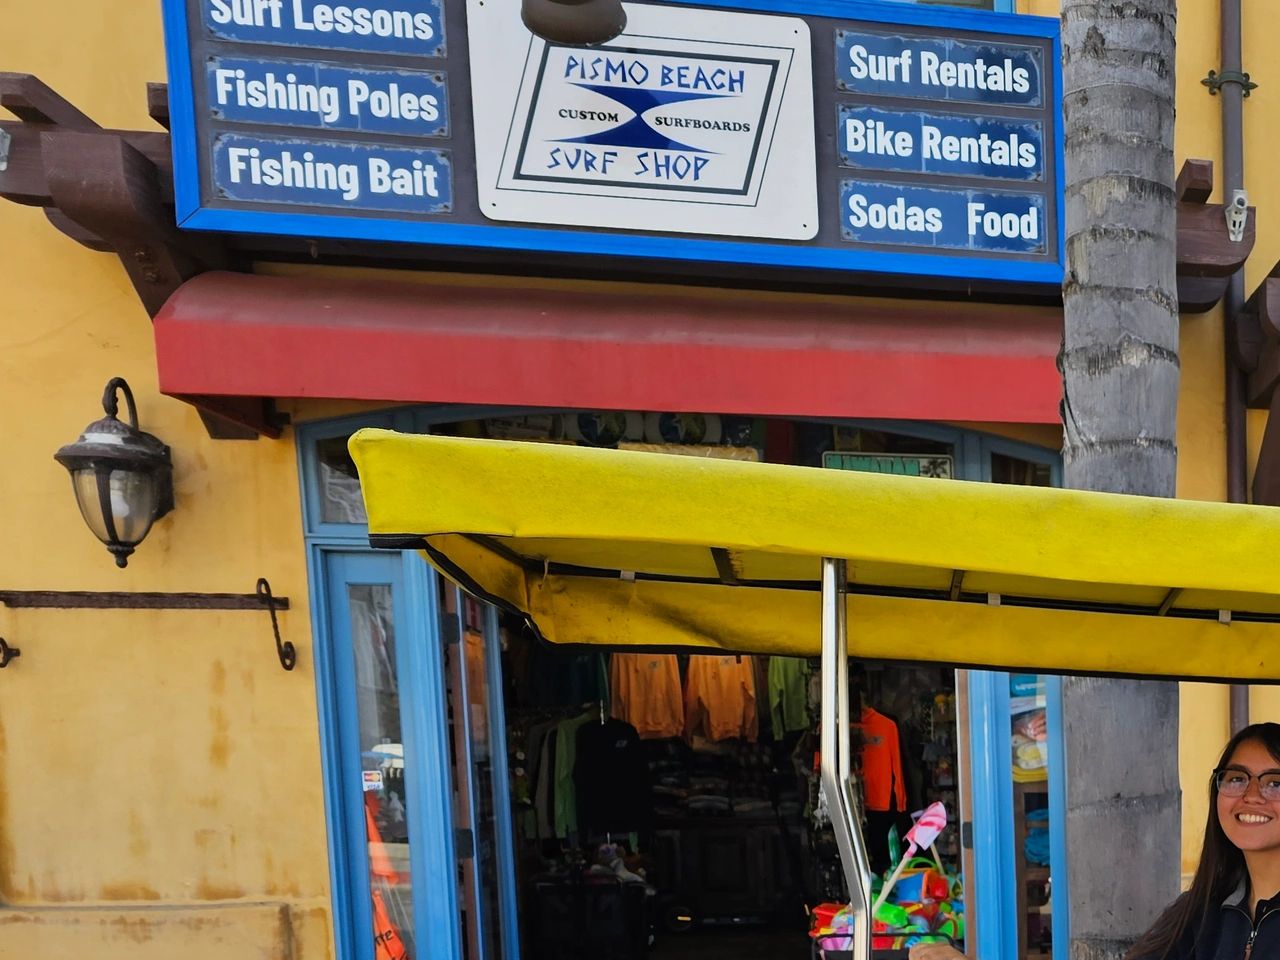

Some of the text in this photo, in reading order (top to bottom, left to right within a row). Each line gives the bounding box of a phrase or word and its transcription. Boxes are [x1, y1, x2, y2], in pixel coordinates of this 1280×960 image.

[210, 0, 434, 40] Surf Lessons
[564, 55, 745, 93] PISMO BEACH
[849, 44, 1030, 94] Surf Rentals
[215, 69, 439, 122] Fishing Poles
[558, 108, 751, 133] CUSTOM SURFBOARDS
[845, 119, 1036, 168] Bike Rentals
[228, 148, 439, 201] Fishing Bait
[547, 147, 710, 181] SURF SHOP
[848, 193, 1038, 241] Sodas Food
